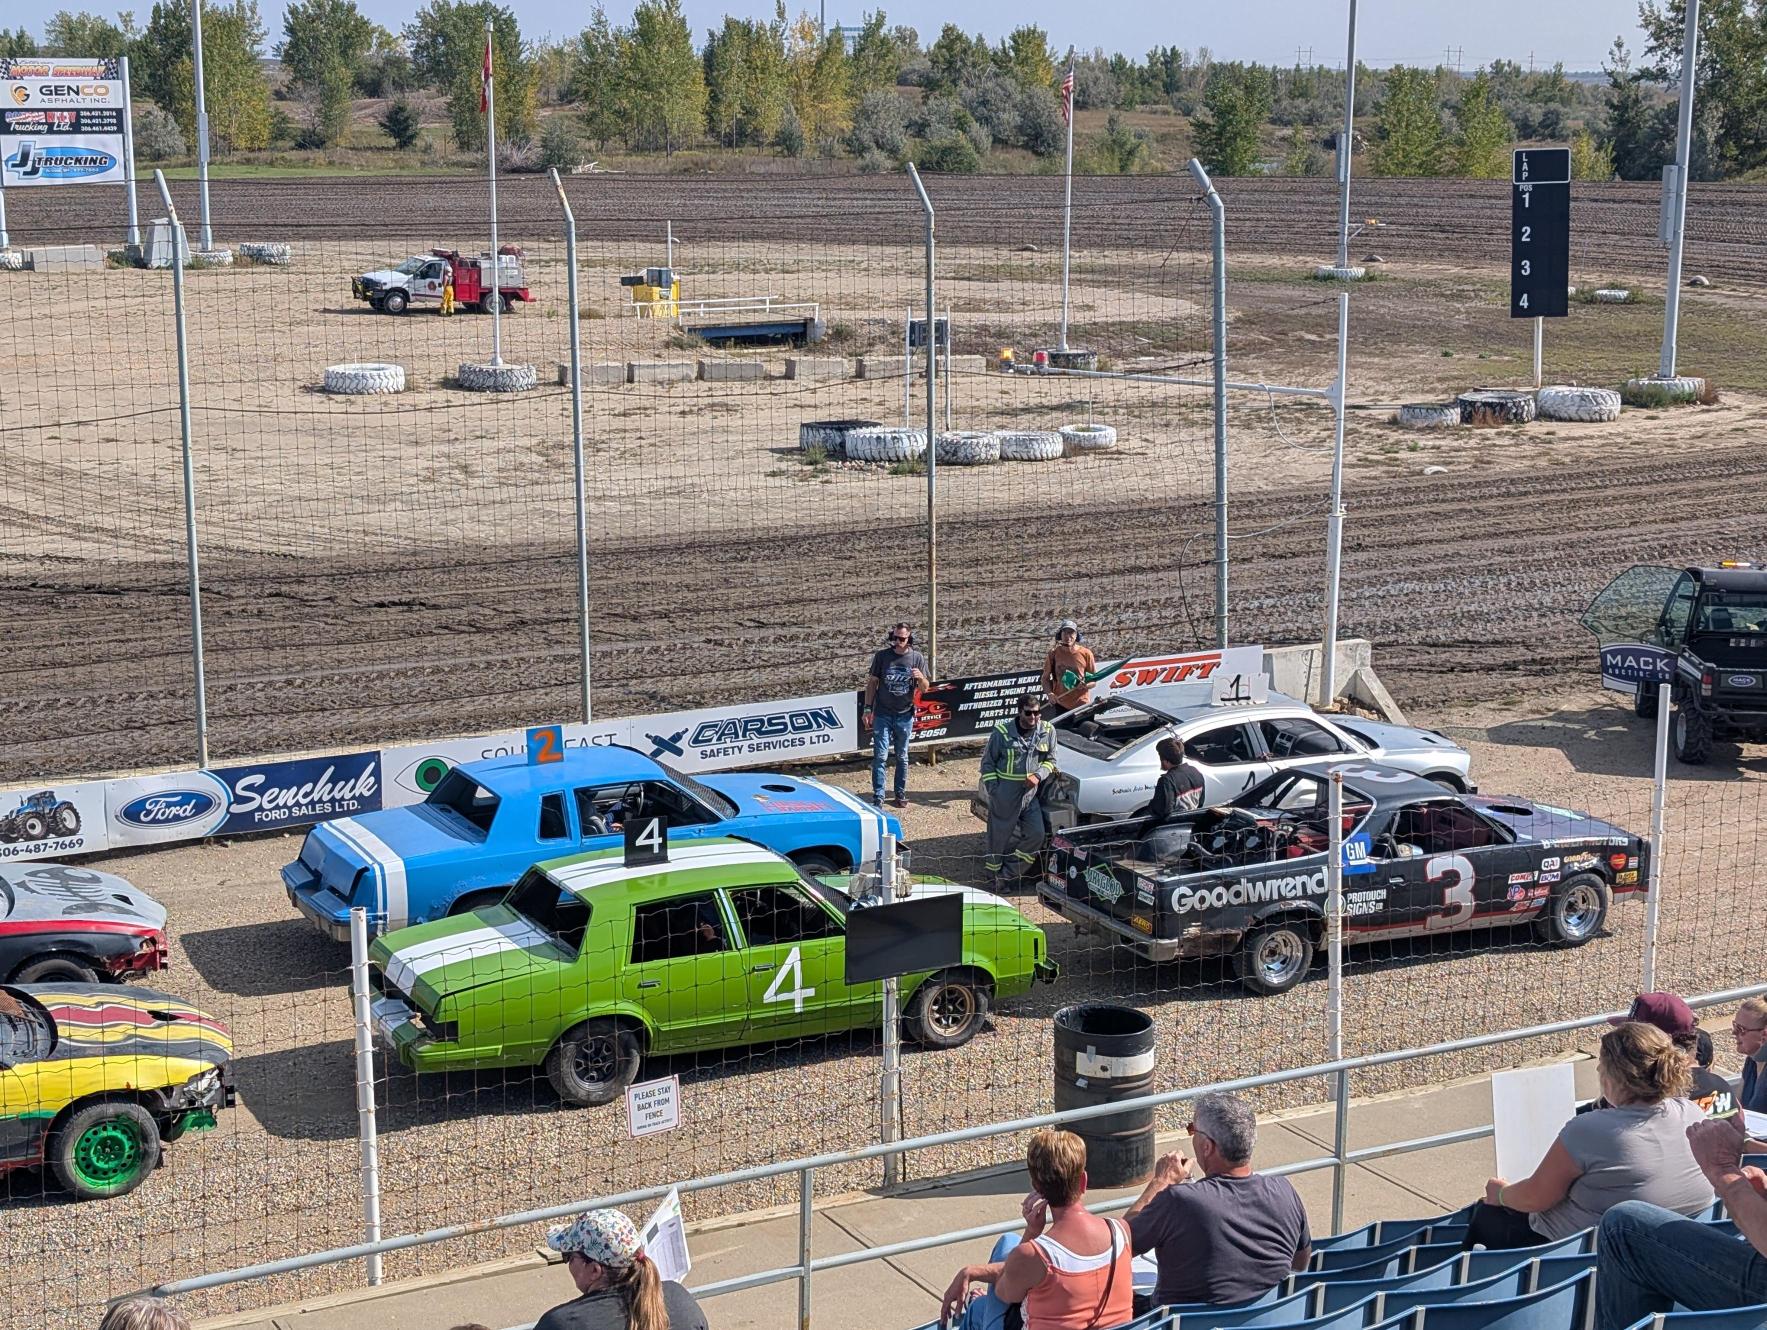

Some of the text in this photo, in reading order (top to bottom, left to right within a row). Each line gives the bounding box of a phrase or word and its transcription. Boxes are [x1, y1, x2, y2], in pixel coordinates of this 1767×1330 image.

[10, 65, 50, 77] MOTOR
[39, 85, 110, 97] GENCO
[11, 121, 73, 133] Trucking Ltd.
[36, 156, 109, 167] TRUCKING
[1522, 192, 1529, 208] 1
[1521, 226, 1531, 242] 2
[1521, 260, 1531, 276] 3
[1519, 293, 1529, 309] 4
[1606, 654, 1671, 672] MACK
[963, 675, 1041, 691] AFTERMARKET HEAVY
[1109, 662, 1222, 689] SWIFT
[973, 690, 999, 699] DIESEL
[999, 687, 1026, 696] ENGINE
[1220, 674, 1251, 702] 1
[958, 700, 1003, 711] AUTHORIZED
[979, 709, 1004, 718] PARTS
[688, 706, 844, 748] CARSON
[974, 720, 994, 728] LOAD
[533, 730, 563, 762] 2
[700, 733, 834, 760] SAFETY SERVICES LTD.
[229, 761, 378, 813] Senchuk
[139, 795, 196, 822] Ford
[254, 799, 361, 823] FORD SALES LTD.
[635, 817, 663, 854] 4
[1346, 841, 1366, 860] GM
[1347, 889, 1387, 904] PROTOUCH
[1424, 855, 1475, 931] 3
[1347, 901, 1376, 917] SIGNS
[763, 946, 815, 1013] 4
[633, 1085, 672, 1101] PLEASE STAY
[637, 1097, 670, 1112] BACK FROM
[645, 1109, 663, 1121] FENCE
